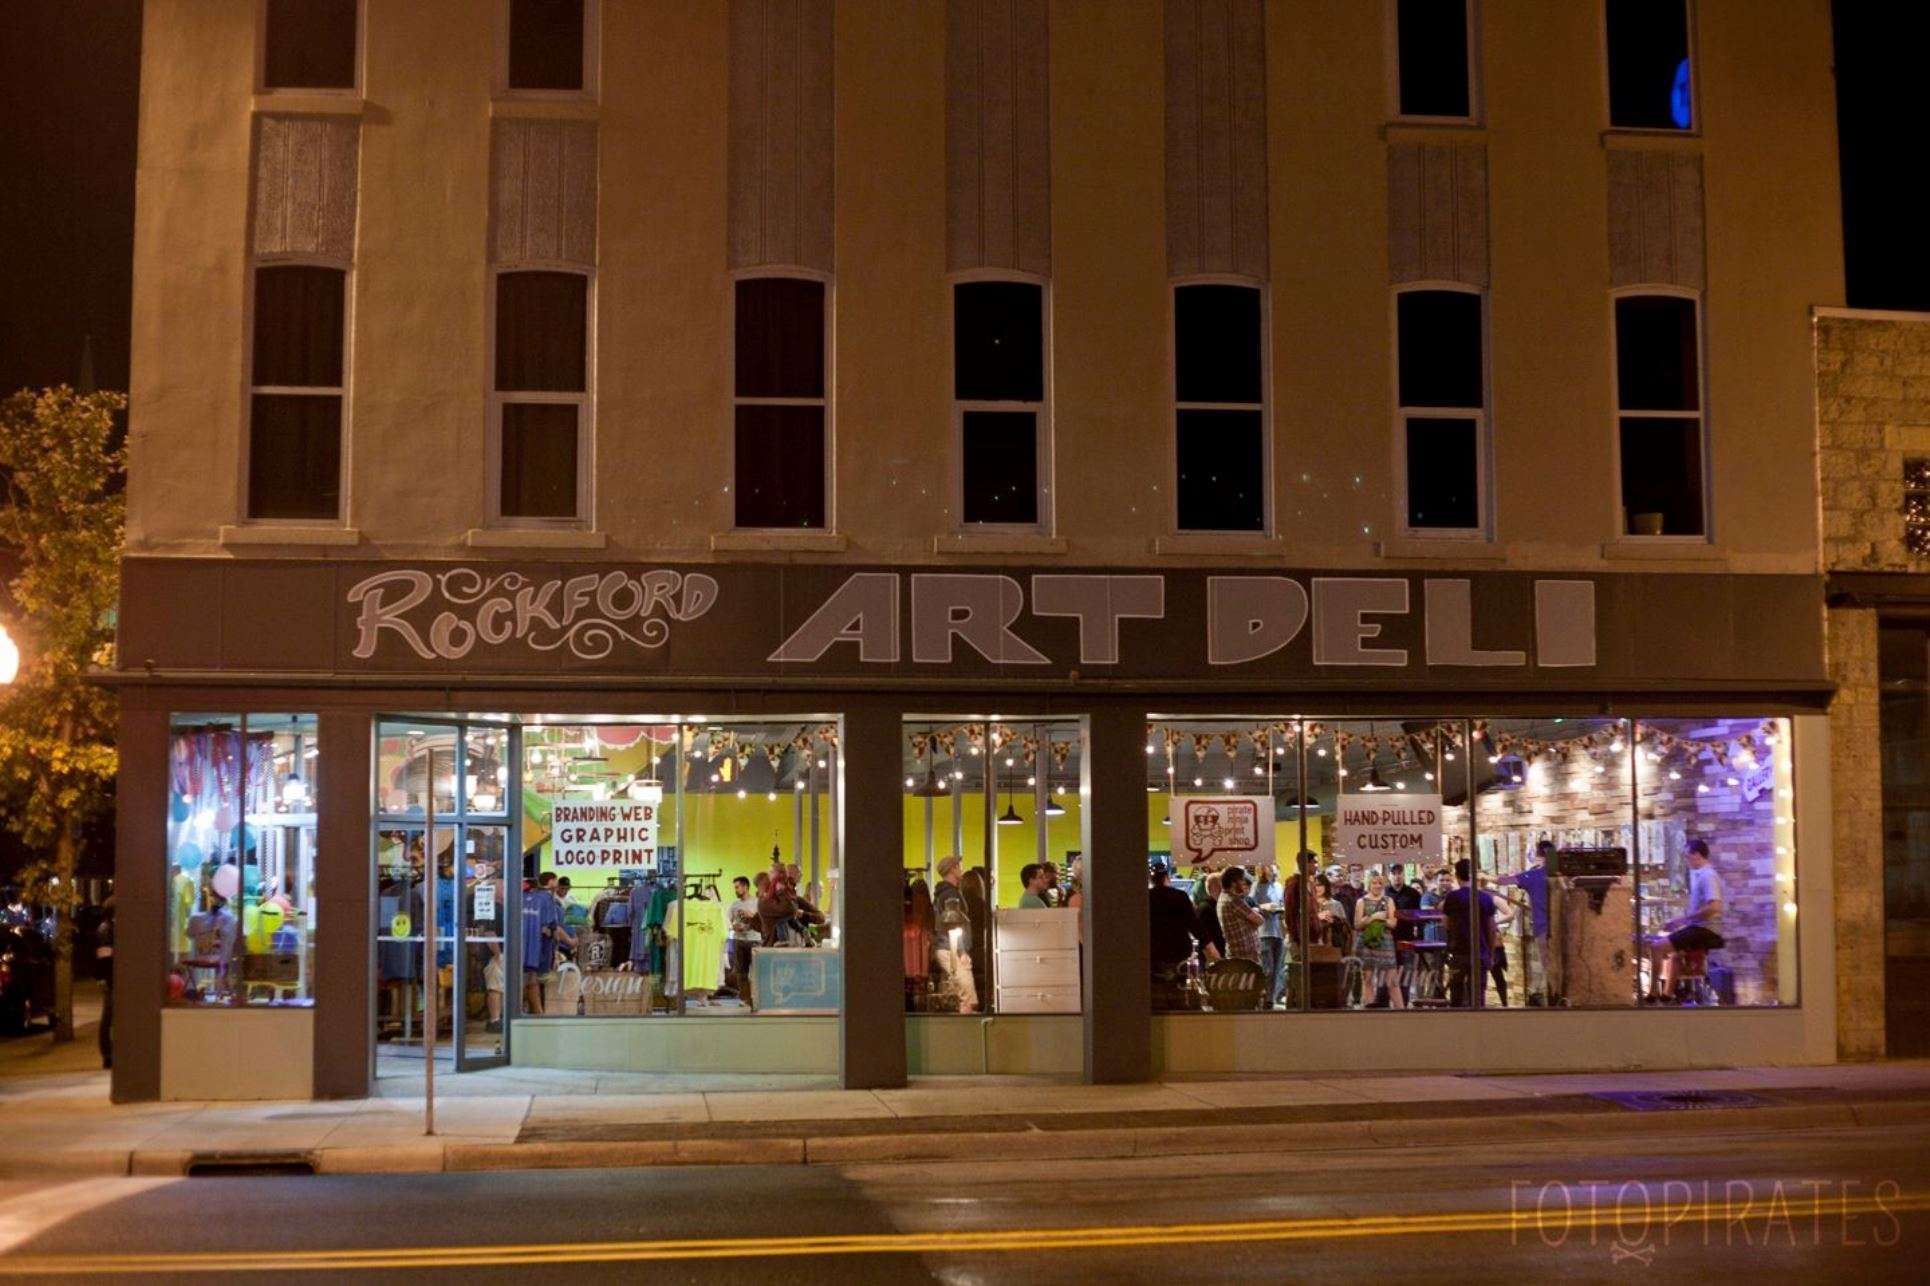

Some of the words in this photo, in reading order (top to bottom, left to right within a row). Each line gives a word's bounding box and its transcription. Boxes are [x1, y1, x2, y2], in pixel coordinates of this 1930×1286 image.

[347, 570, 719, 660] ROCKFORD
[767, 573, 1164, 664] ART
[1208, 576, 1597, 667] DELI
[555, 806, 616, 822] BRANDING
[620, 805, 653, 821] WEB
[560, 827, 649, 843] GRAPHIC
[1357, 833, 1424, 849] CUSTOM
[555, 849, 595, 865] LOGO
[601, 848, 654, 865] PRINT
